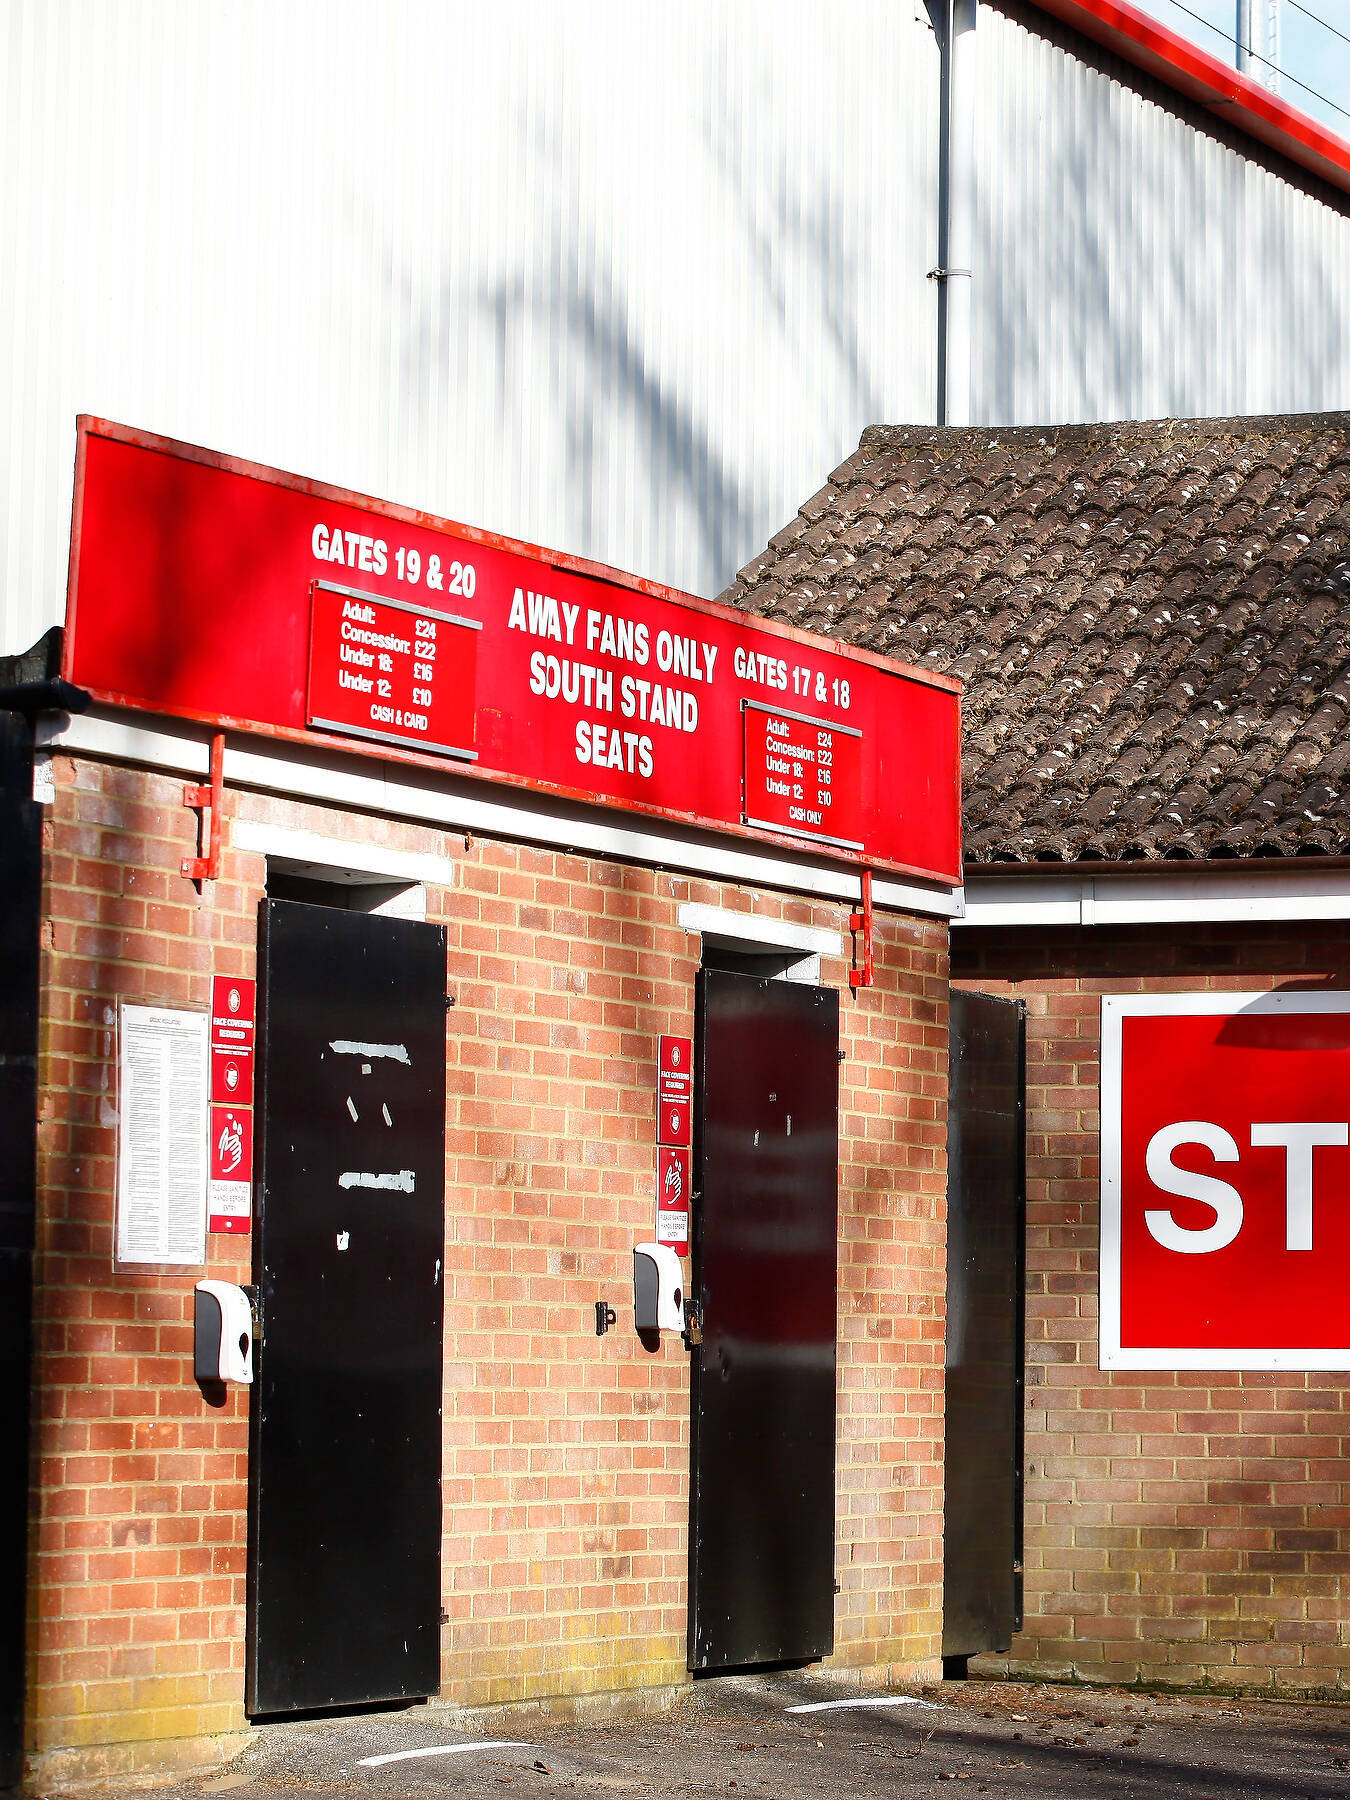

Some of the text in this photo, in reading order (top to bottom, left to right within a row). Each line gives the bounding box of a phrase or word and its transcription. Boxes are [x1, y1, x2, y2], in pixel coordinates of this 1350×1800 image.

[311, 523, 477, 599] GATES 19 & 20
[342, 600, 437, 639] Adult: £24
[507, 587, 719, 684] AWAY FANS ONLY
[341, 621, 436, 661] Concession: £22
[340, 643, 375, 668] Under
[413, 662, 433, 682] £16
[733, 646, 851, 710] GATES 17 & 18
[339, 669, 374, 693] Under
[412, 687, 432, 707] £10
[529, 650, 699, 734] SOUTH STAND
[370, 704, 428, 731] CASH & CARD
[766, 717, 833, 749] Adult: £24
[575, 719, 654, 778] SEATS
[766, 735, 833, 767] Concession: £22
[766, 754, 791, 775] Under
[817, 768, 831, 785] £16
[766, 776, 791, 797] Under
[817, 790, 832, 807] £10
[789, 805, 823, 825] CASH ONLY
